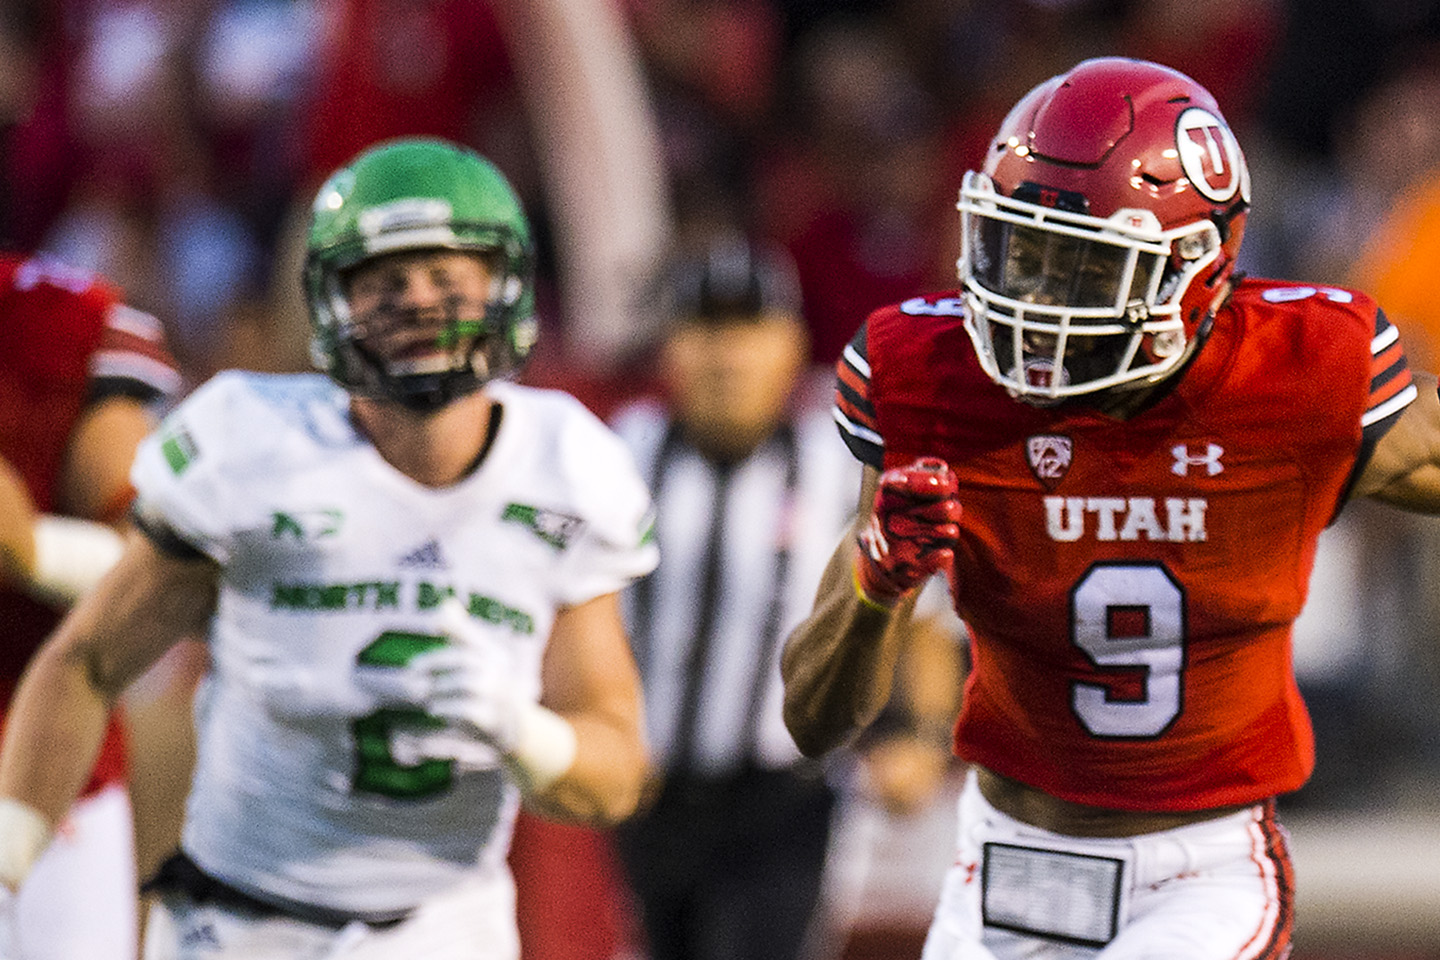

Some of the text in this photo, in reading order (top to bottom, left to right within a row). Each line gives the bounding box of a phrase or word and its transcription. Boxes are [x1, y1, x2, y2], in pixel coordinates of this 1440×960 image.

[1044, 497, 1208, 543] UTAH
[268, 582, 401, 613] NORTH
[1070, 560, 1188, 741] 9
